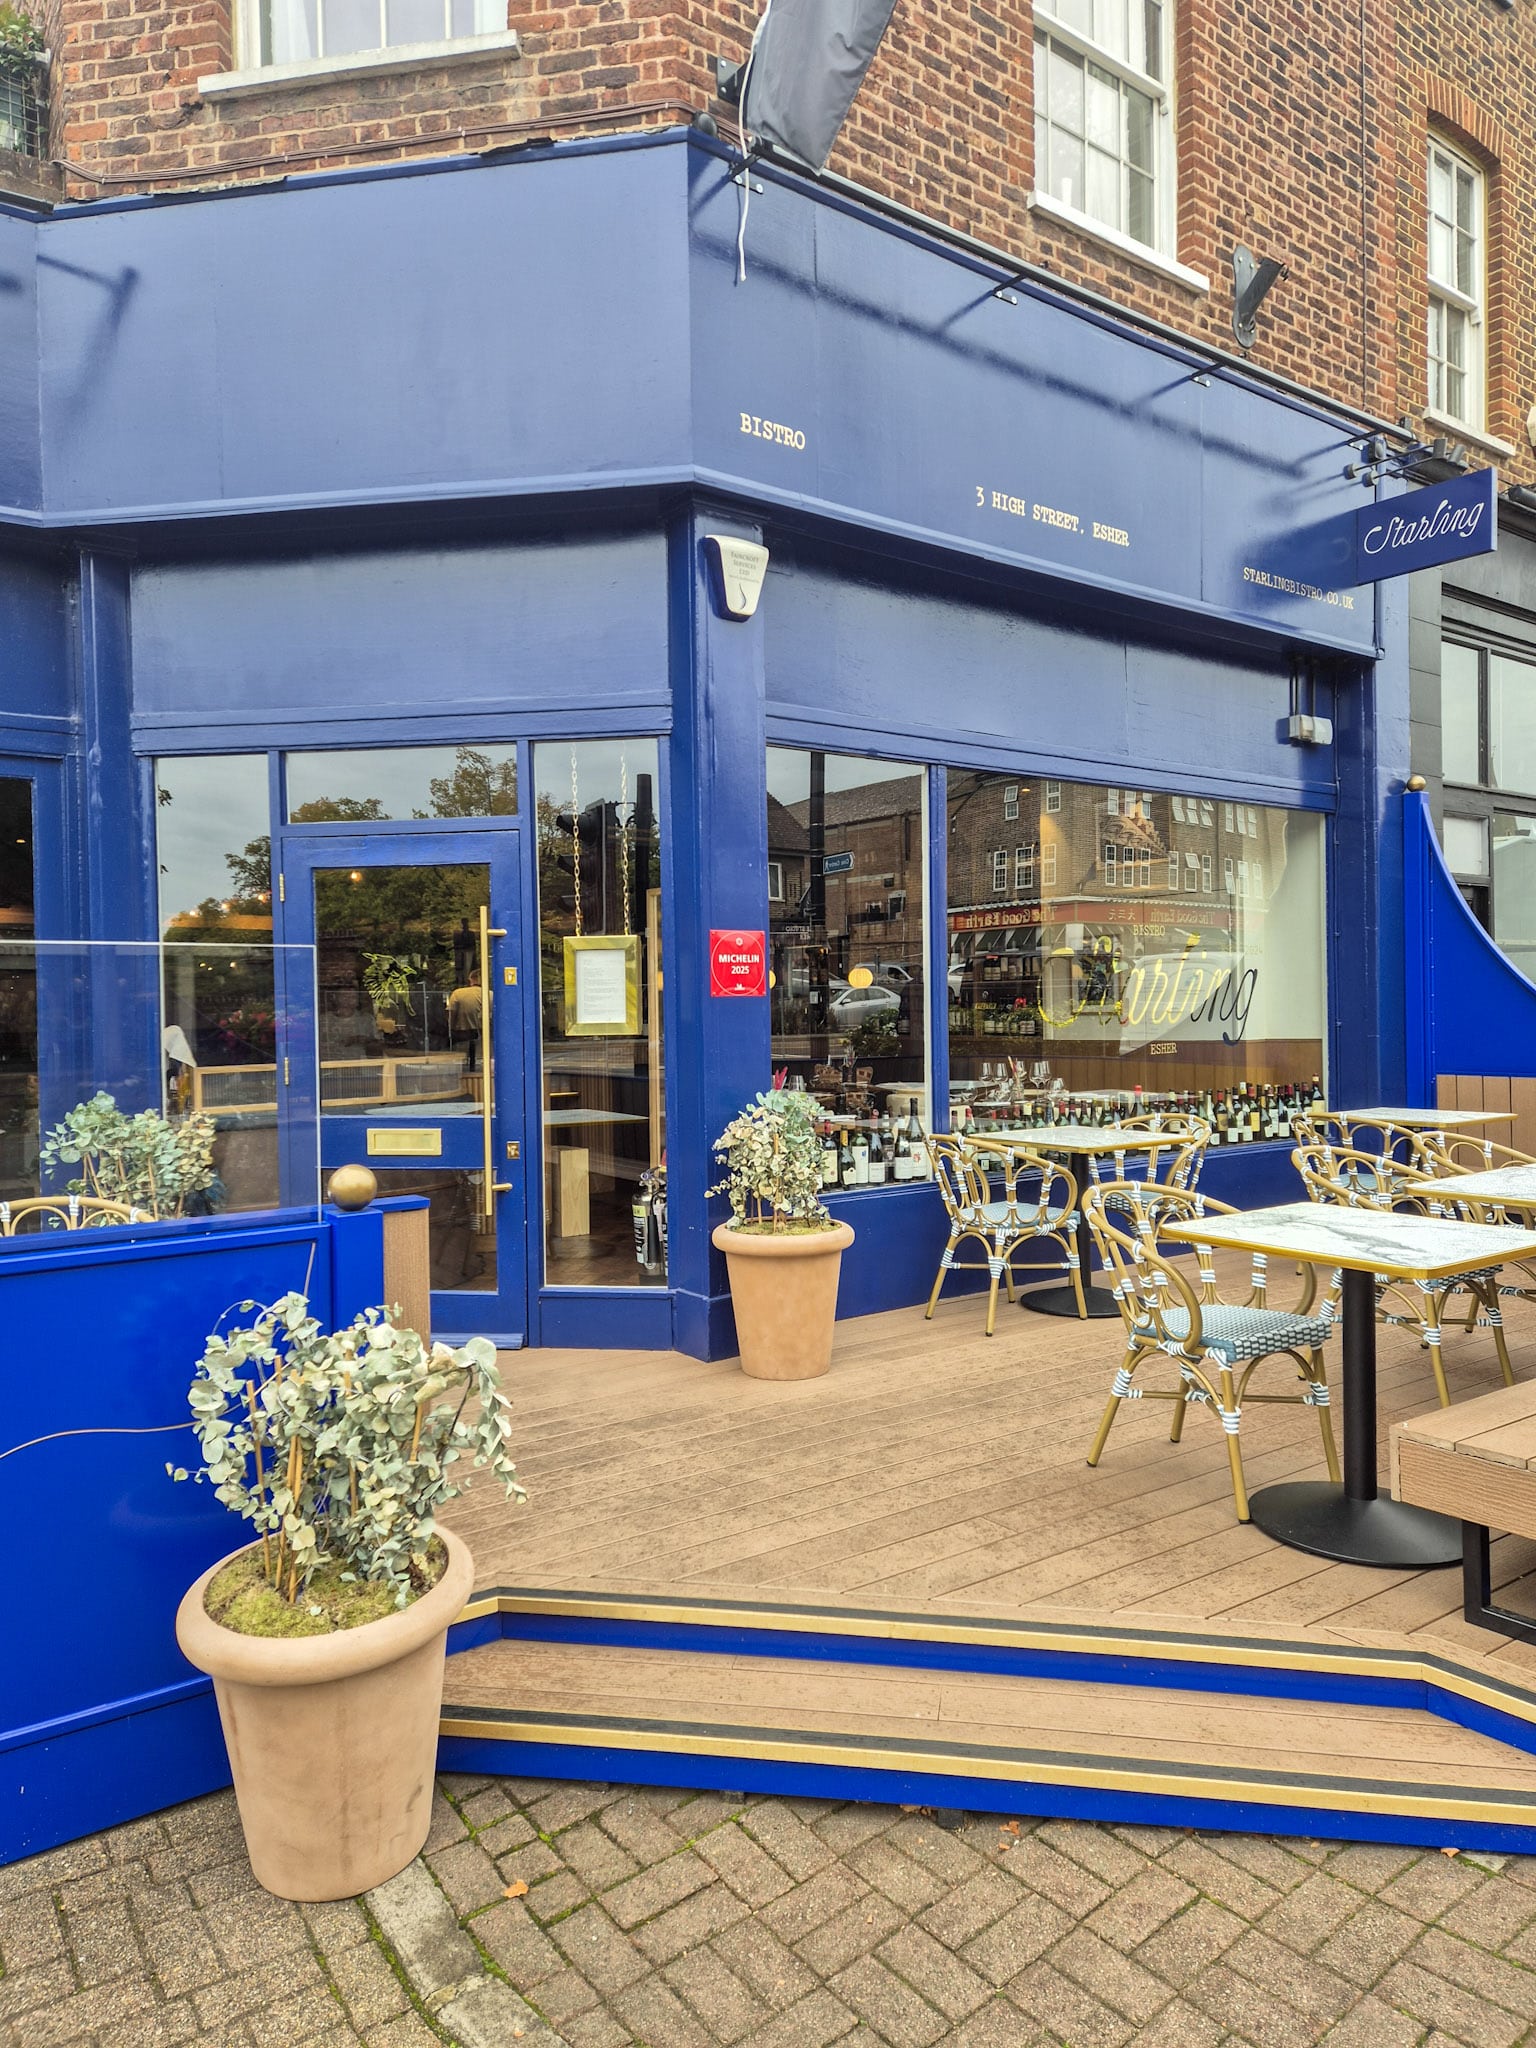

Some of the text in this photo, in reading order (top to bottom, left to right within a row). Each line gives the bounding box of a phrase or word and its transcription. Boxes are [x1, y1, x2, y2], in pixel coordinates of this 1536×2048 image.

[740, 412, 806, 451] BISTRO
[975, 486, 985, 507] 3
[992, 491, 1026, 517] HIGH
[1093, 522, 1130, 547] ESHER
[1363, 499, 1485, 555] Starling
[1243, 567, 1354, 610] STARLINGBISTRO.CO.UK
[718, 953, 760, 964] MICHELIN
[731, 965, 750, 975] 2025
[1150, 1042, 1178, 1055] ESHER
